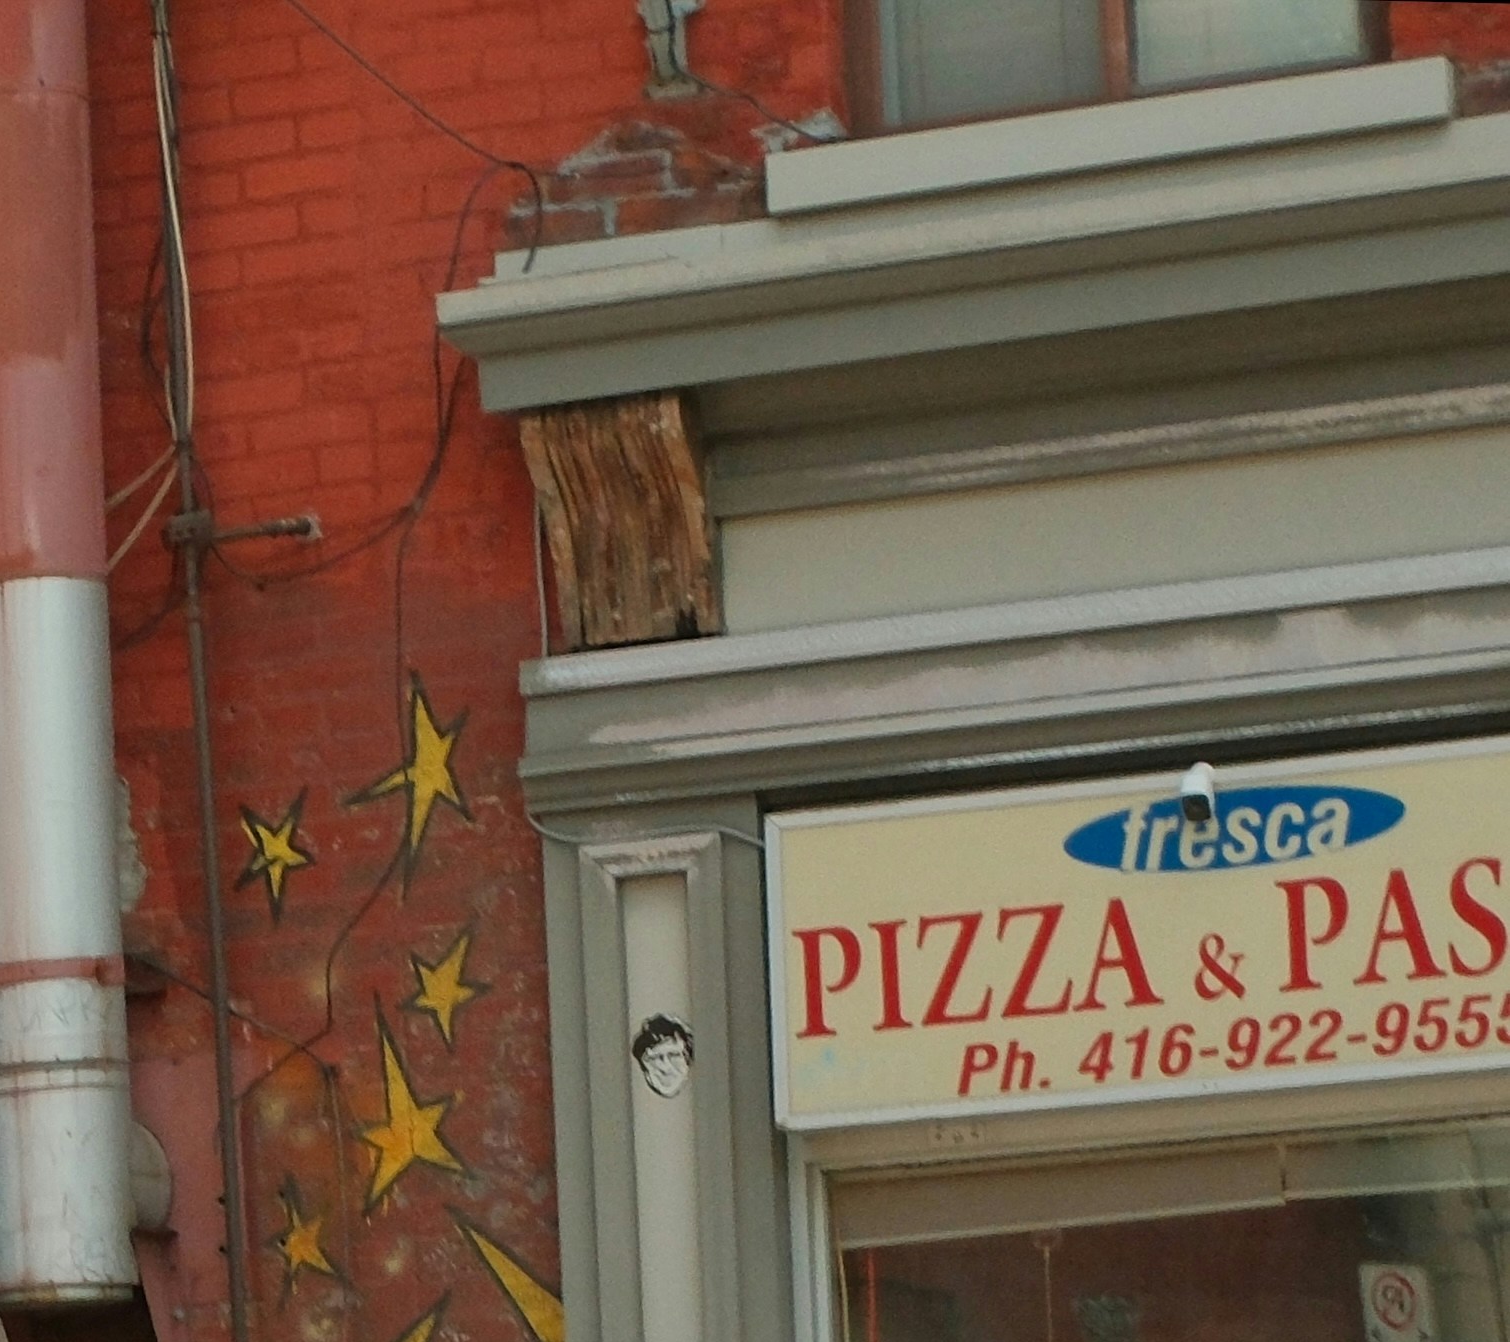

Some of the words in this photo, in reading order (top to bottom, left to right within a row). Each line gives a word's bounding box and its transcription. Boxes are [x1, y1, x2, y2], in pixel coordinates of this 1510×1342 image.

[1121, 797, 1351, 872] fresca
[792, 895, 1165, 1040] PIZZA
[1194, 932, 1246, 1001] &
[958, 1040, 1051, 1096] Ph.
